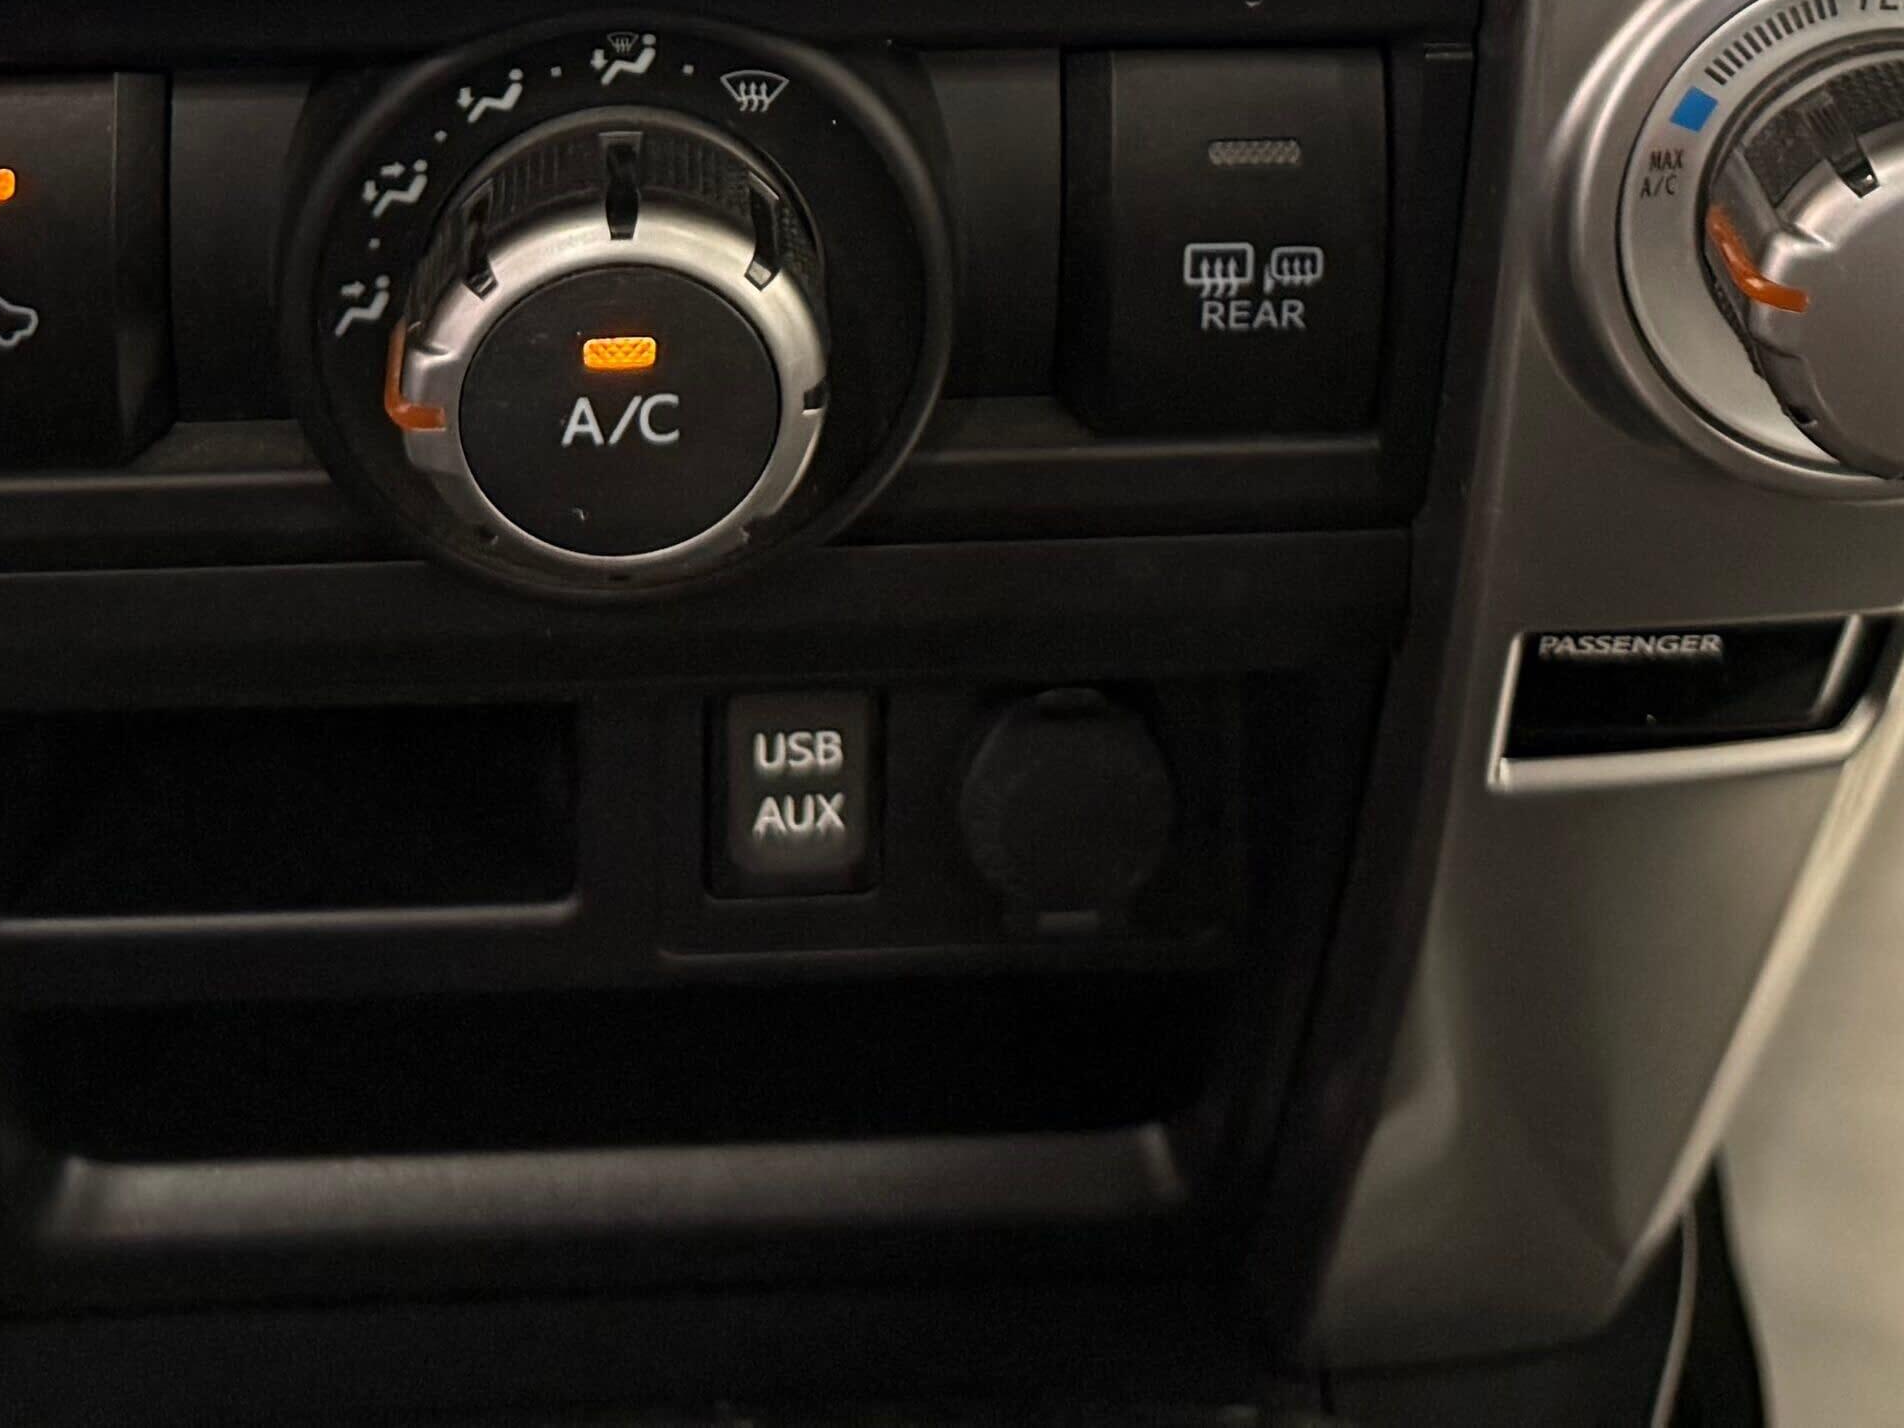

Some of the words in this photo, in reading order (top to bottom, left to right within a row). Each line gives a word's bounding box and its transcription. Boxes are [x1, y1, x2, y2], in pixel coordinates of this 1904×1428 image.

[1648, 147, 1685, 172] MAX
[1639, 173, 1678, 199] A/C
[1200, 298, 1307, 331] REAR
[560, 392, 681, 445] A/C
[1538, 633, 1723, 658] PASSENGER
[753, 730, 844, 772] USB
[752, 792, 847, 836] AUX
